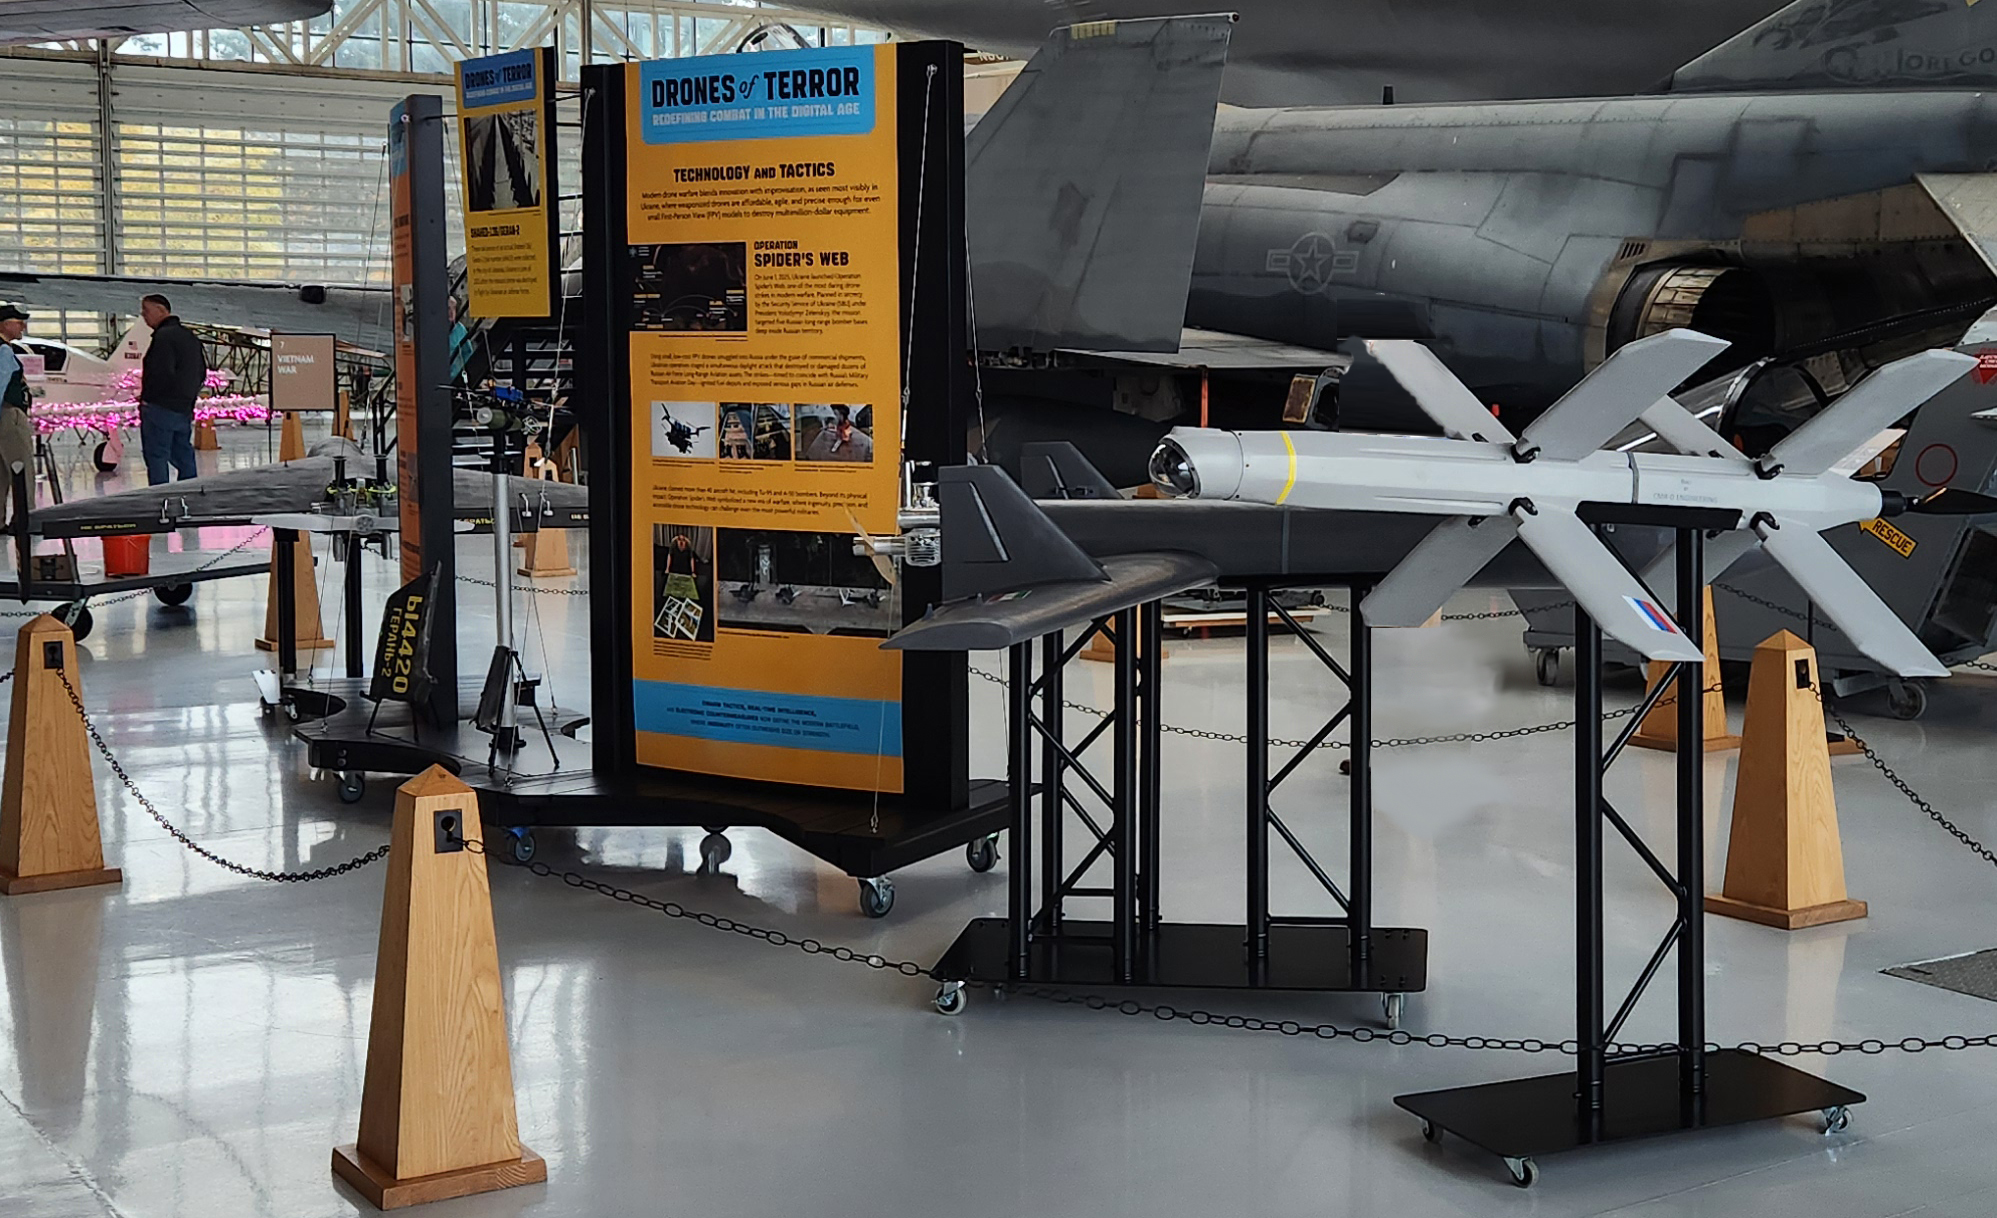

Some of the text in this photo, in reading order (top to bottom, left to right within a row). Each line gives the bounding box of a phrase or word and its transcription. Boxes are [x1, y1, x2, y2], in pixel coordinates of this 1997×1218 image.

[502, 63, 532, 83] TERROR
[652, 66, 860, 108] DRONES of TERROR
[652, 102, 860, 126] REDEFINING COMBAT IN THE DIGITAL AGE
[673, 162, 835, 183] TECHNOLOGY AND TACTICS
[753, 240, 798, 250] OPERATION
[754, 251, 849, 268] SPIDER'S WEB
[280, 341, 285, 349] 7
[277, 354, 315, 364] VIETNAM
[277, 365, 297, 374] WAR
[1872, 519, 1913, 553] RESCUE
[381, 607, 403, 678] ГЕРАНЬ-2
